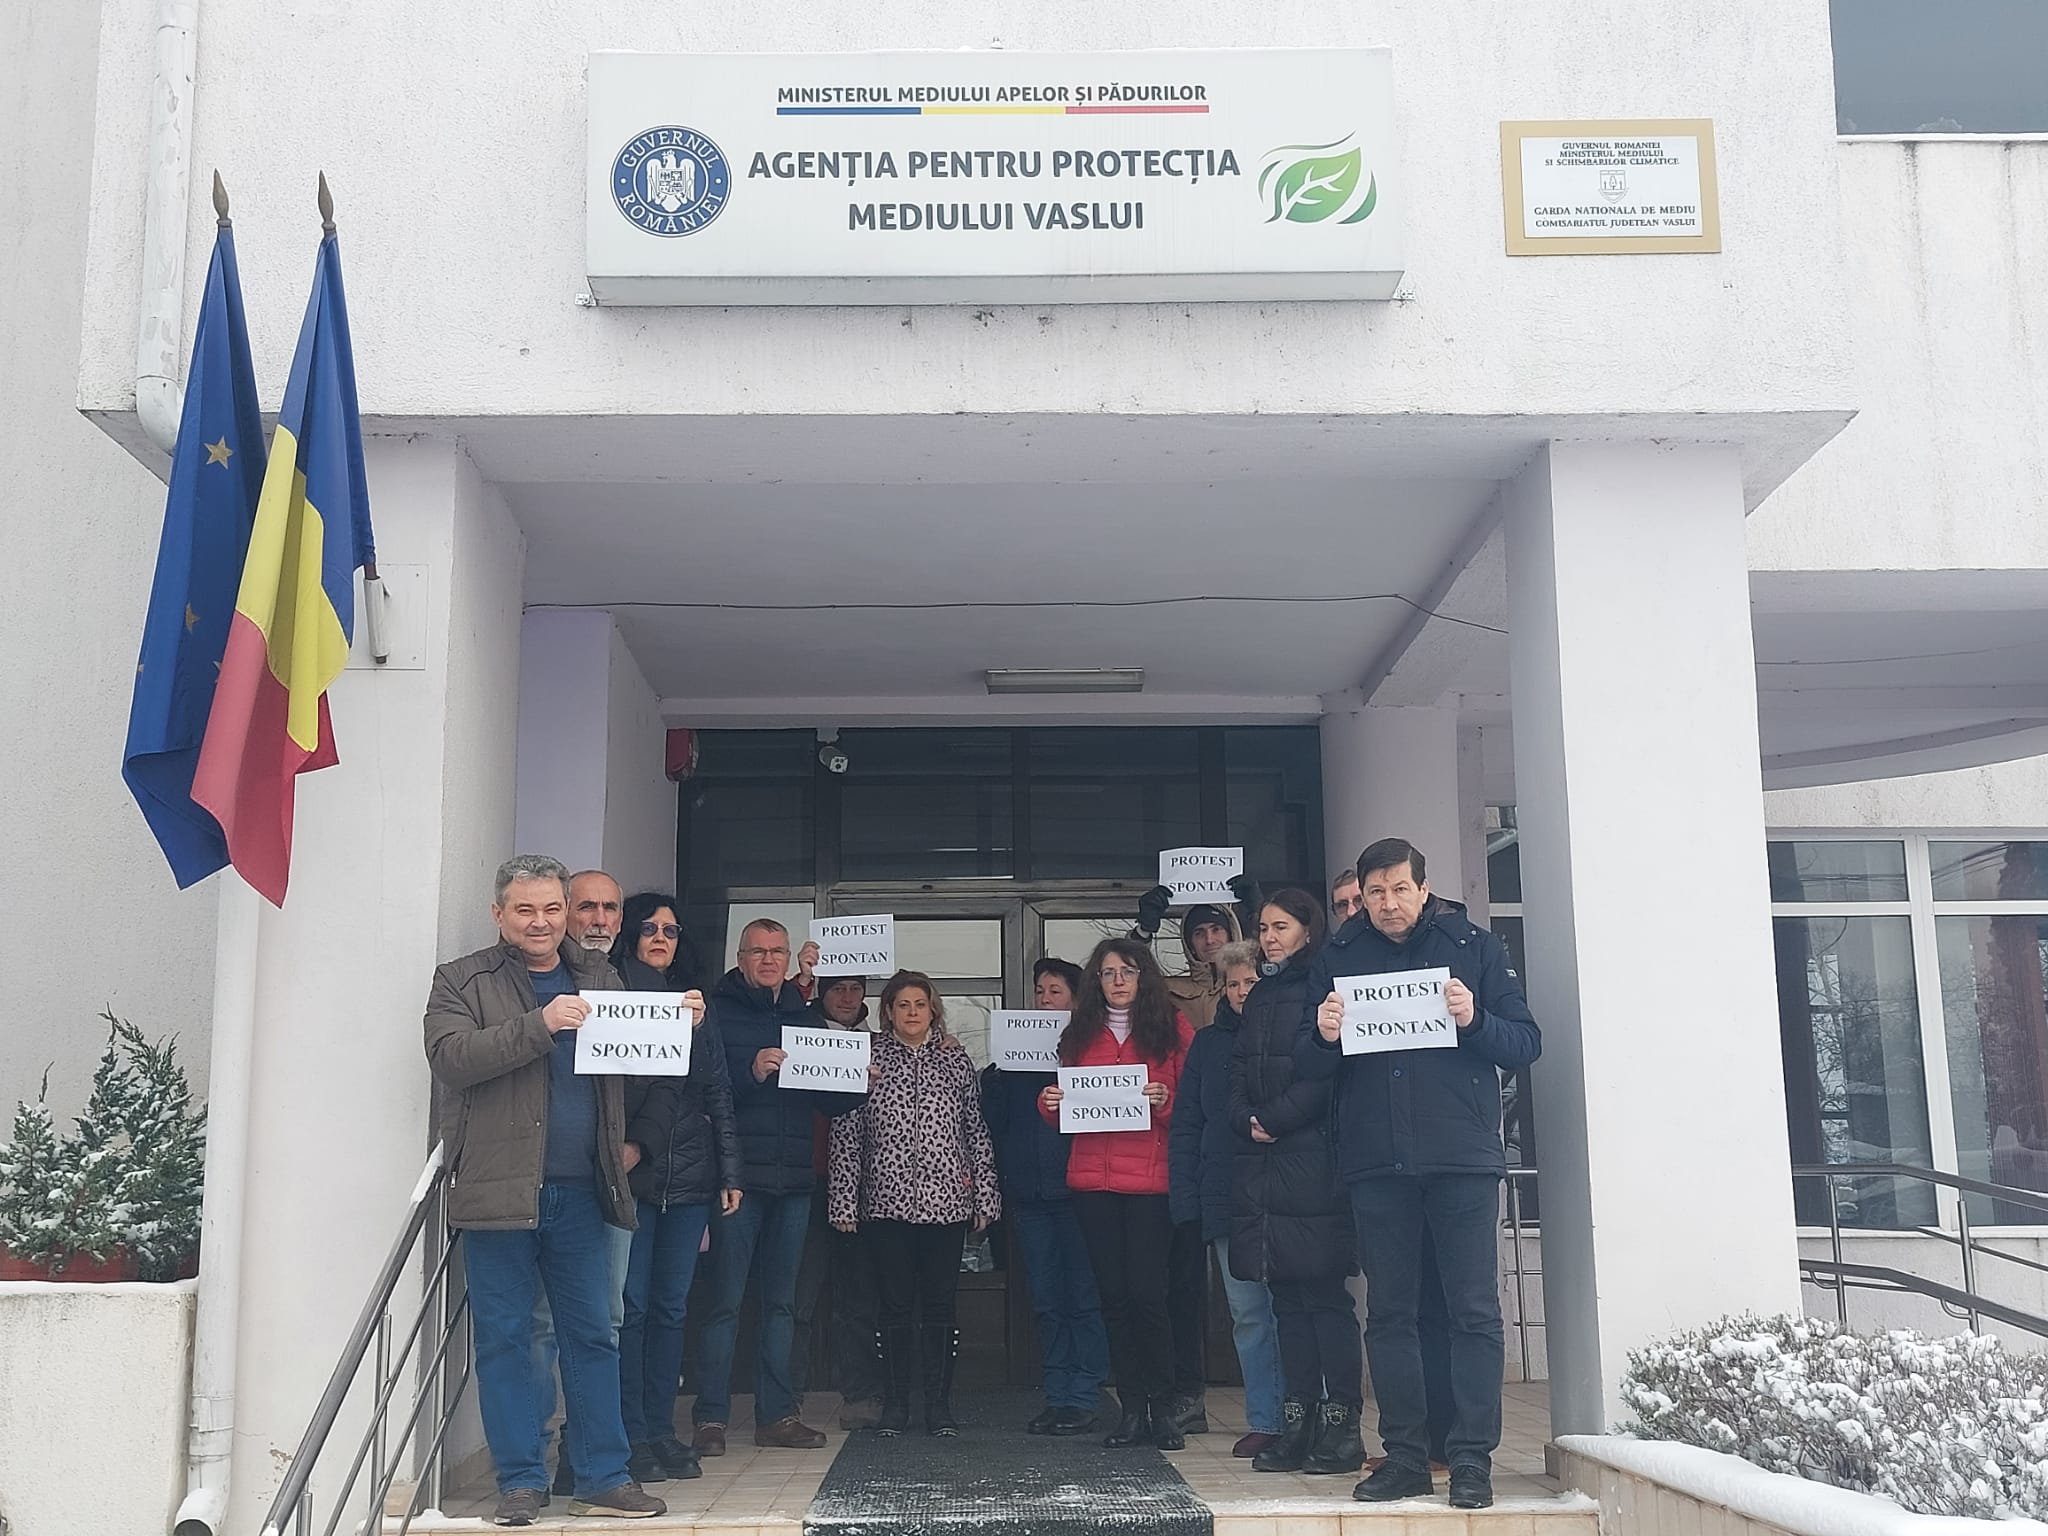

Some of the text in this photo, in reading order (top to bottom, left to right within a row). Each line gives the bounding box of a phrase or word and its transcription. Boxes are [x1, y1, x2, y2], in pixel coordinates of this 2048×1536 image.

[778, 82, 1207, 106] MINISTERUL MEDIULUI APELOR ȘI PĂDURILOR
[621, 129, 720, 169] GUVERNUL
[1562, 142, 1611, 150] GUVERNUL
[1559, 150, 1615, 158] MINISTERUL
[747, 149, 1241, 187] AGENȚIA PENTRU PROTECȚIA
[1545, 159, 1553, 167] SI
[1556, 158, 1626, 166] SCHIMBARILOR
[620, 192, 723, 232] ROMÂNIEI
[848, 202, 1143, 231] MEDIULUI VASLUI
[1534, 205, 1696, 215] GARDA NATIONALA DE MEDIU
[1535, 219, 1696, 229] COMISARIATUL JUDETEAN VASLUI
[1170, 855, 1236, 868] PROTEST
[1169, 880, 1234, 893] SPONTA
[821, 924, 887, 937] PROTEST
[821, 951, 888, 966] SPONTAN
[1353, 981, 1442, 1001] PROTEST
[596, 1004, 684, 1020] PROTEST
[1007, 1019, 1060, 1029] PROTEST
[1355, 1018, 1448, 1038] SPONTAN
[795, 1035, 864, 1050] PROTEST
[591, 1043, 682, 1059] SPONTAN
[791, 1064, 863, 1080] SPONTAN
[1071, 1075, 1141, 1089] PROTEST
[1072, 1106, 1144, 1120] SPONTAN
